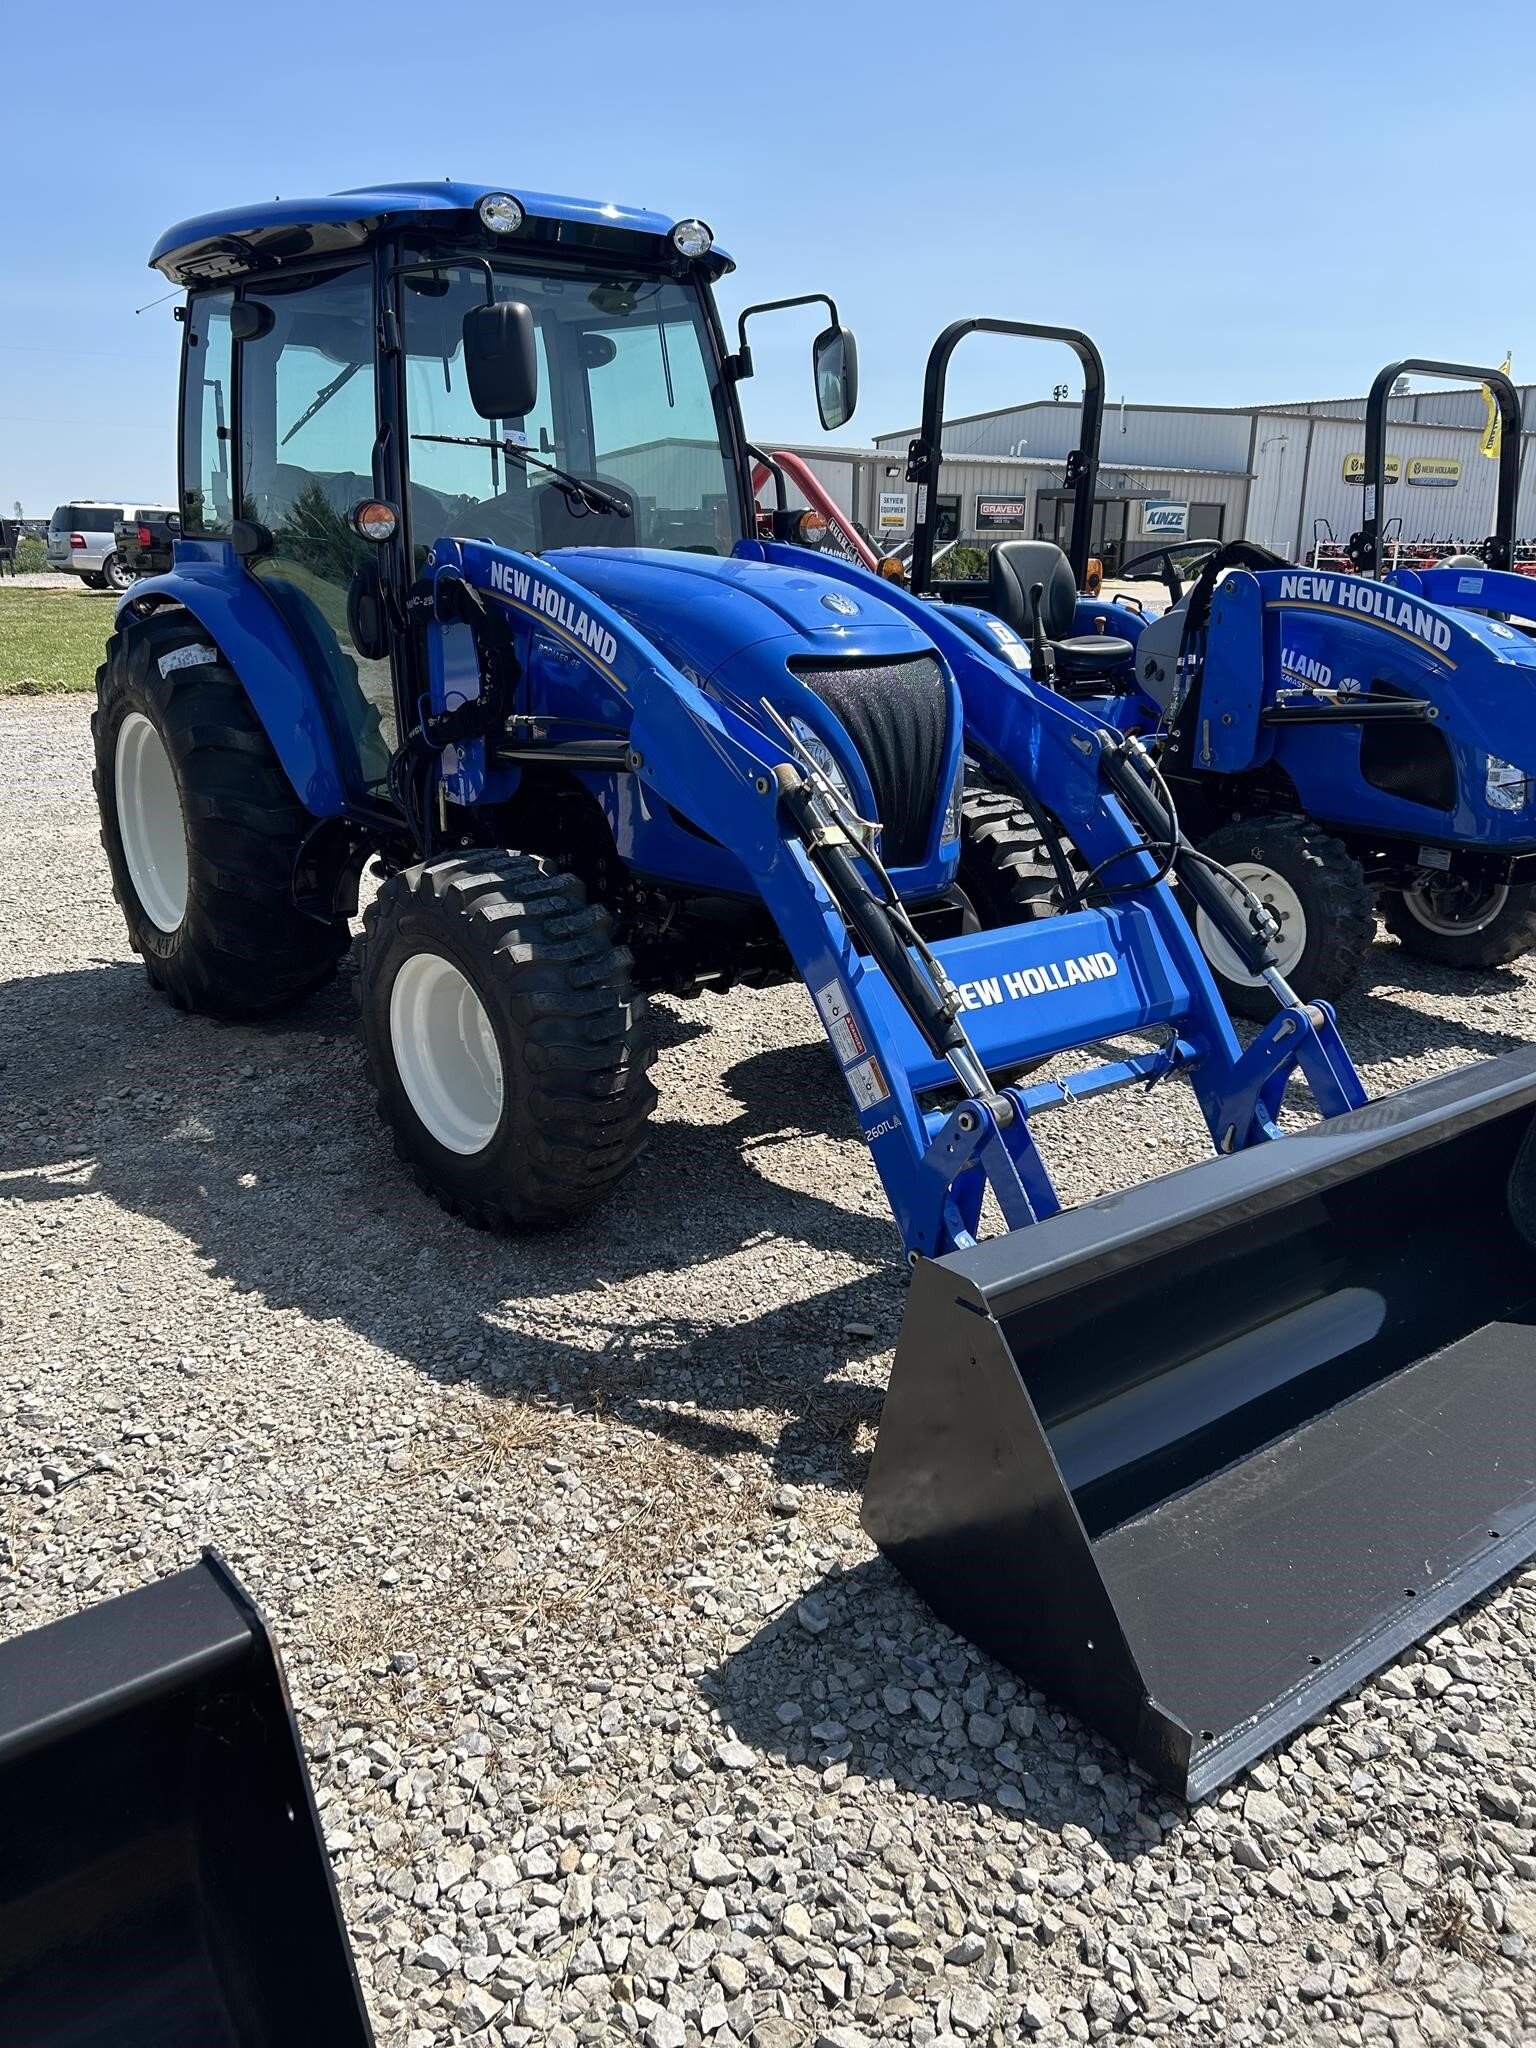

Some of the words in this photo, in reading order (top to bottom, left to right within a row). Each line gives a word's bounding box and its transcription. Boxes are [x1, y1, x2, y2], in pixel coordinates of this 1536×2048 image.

[1421, 465, 1435, 474] NEW
[1435, 466, 1459, 475] HOLLAND
[982, 505, 1022, 514] GRAVELY
[1147, 511, 1185, 525] KINZE
[829, 519, 849, 551] BUSH
[490, 560, 530, 601] NEW
[532, 579, 617, 665] HOLLAND
[1279, 575, 1334, 603] NEW
[1338, 581, 1451, 652] HOLLAND
[538, 643, 569, 662] BOOMER
[1281, 647, 1332, 688] LLAND
[957, 977, 1004, 1012] EW
[1002, 951, 1118, 1001] HOLLAND
[849, 1021, 865, 1052] DANGER
[865, 1114, 902, 1142] 260TLA
